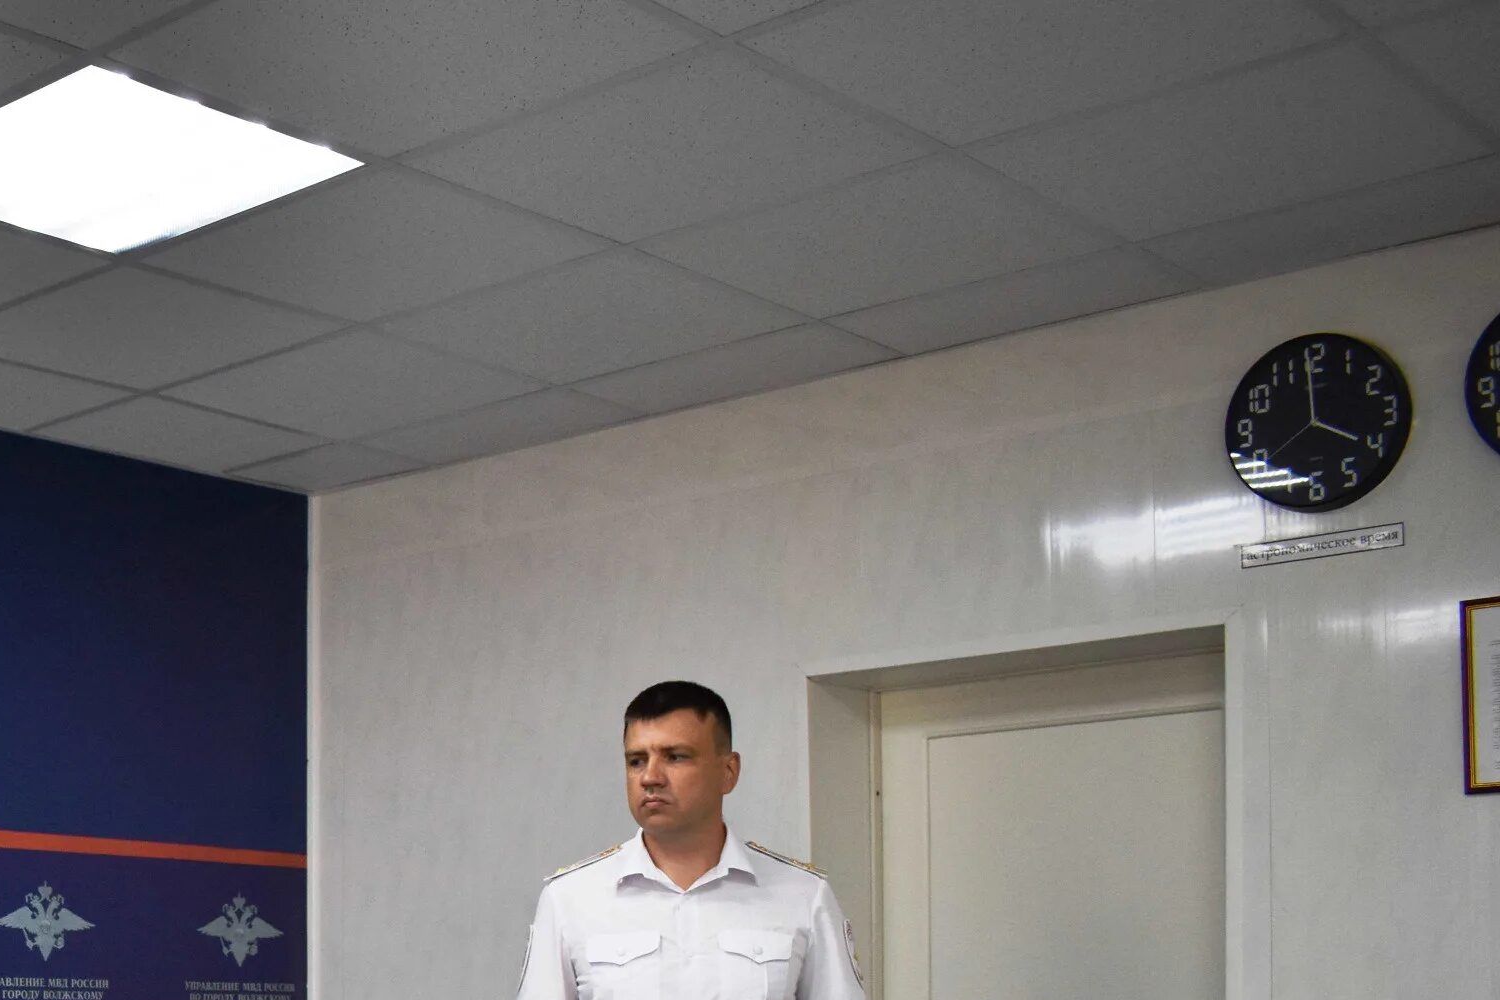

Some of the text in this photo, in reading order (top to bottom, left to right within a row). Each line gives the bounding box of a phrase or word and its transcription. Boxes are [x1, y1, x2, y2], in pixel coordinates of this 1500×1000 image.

[1272, 359, 1294, 387] 11
[1366, 364, 1382, 396] 2
[1249, 384, 1270, 414] 10
[1478, 376, 1495, 408] 9
[1383, 395, 1398, 426] 3
[1237, 418, 1252, 448] 9
[1367, 433, 1383, 459] 4
[1309, 470, 1325, 501] 6
[1341, 457, 1357, 488] 5
[1246, 530, 1398, 561] астрономическое время
[2, 989, 40, 1000] ГОРОДУ
[43, 990, 103, 1000] ВОЛЖСКОМУ
[48, 978, 68, 989] МВД
[71, 978, 109, 989] РОССИИ
